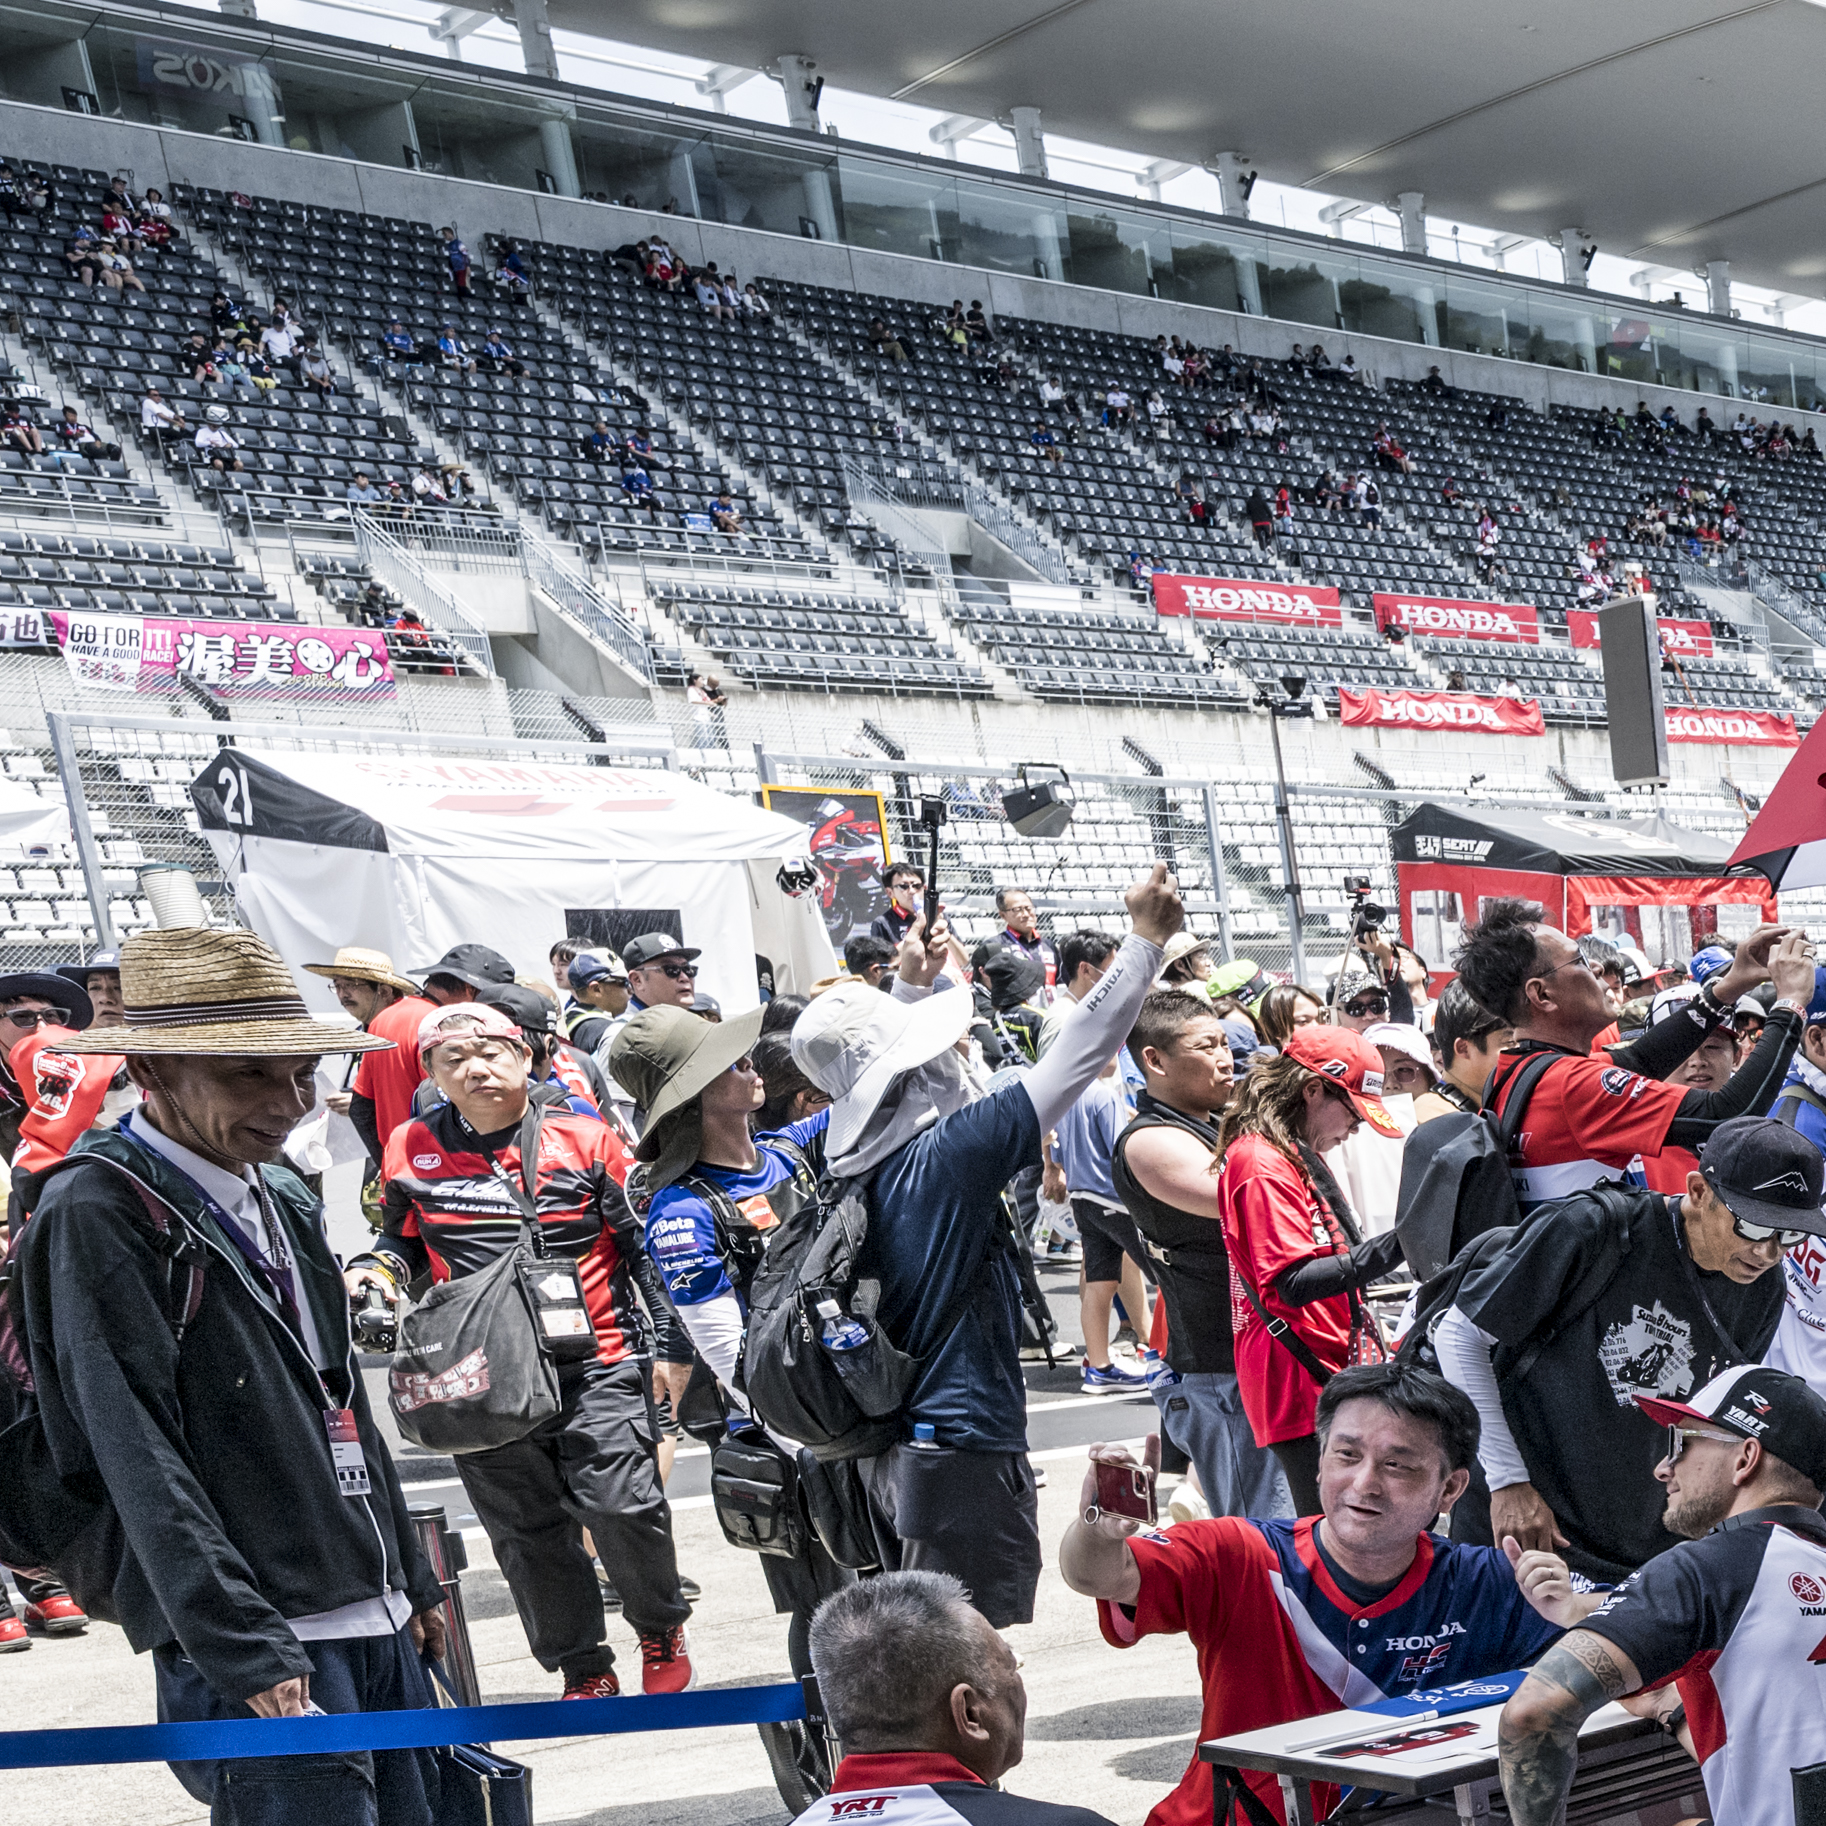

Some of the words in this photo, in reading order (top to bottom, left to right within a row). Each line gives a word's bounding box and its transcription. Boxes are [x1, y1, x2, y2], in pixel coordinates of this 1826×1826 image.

[1182, 584, 1321, 617] HONDA
[70, 624, 98, 641] GO
[1396, 603, 1518, 635] HONDA
[71, 645, 99, 658] HAVE
[103, 647, 110, 658] A
[112, 648, 141, 660] GOOD
[143, 649, 174, 663] RACE!
[1380, 698, 1508, 727] HONDA
[1666, 713, 1763, 740] HONDA
[218, 768, 255, 825] 21
[1086, 967, 1124, 1014] TAICHI
[661, 1217, 696, 1232] Beta
[653, 1231, 696, 1249] YAMALUBE
[426, 1342, 444, 1354] CARE
[1744, 1389, 1772, 1416] R1
[1726, 1405, 1770, 1432] YART
[1386, 1621, 1467, 1652] HONDA
[830, 1795, 898, 1816] YRT
